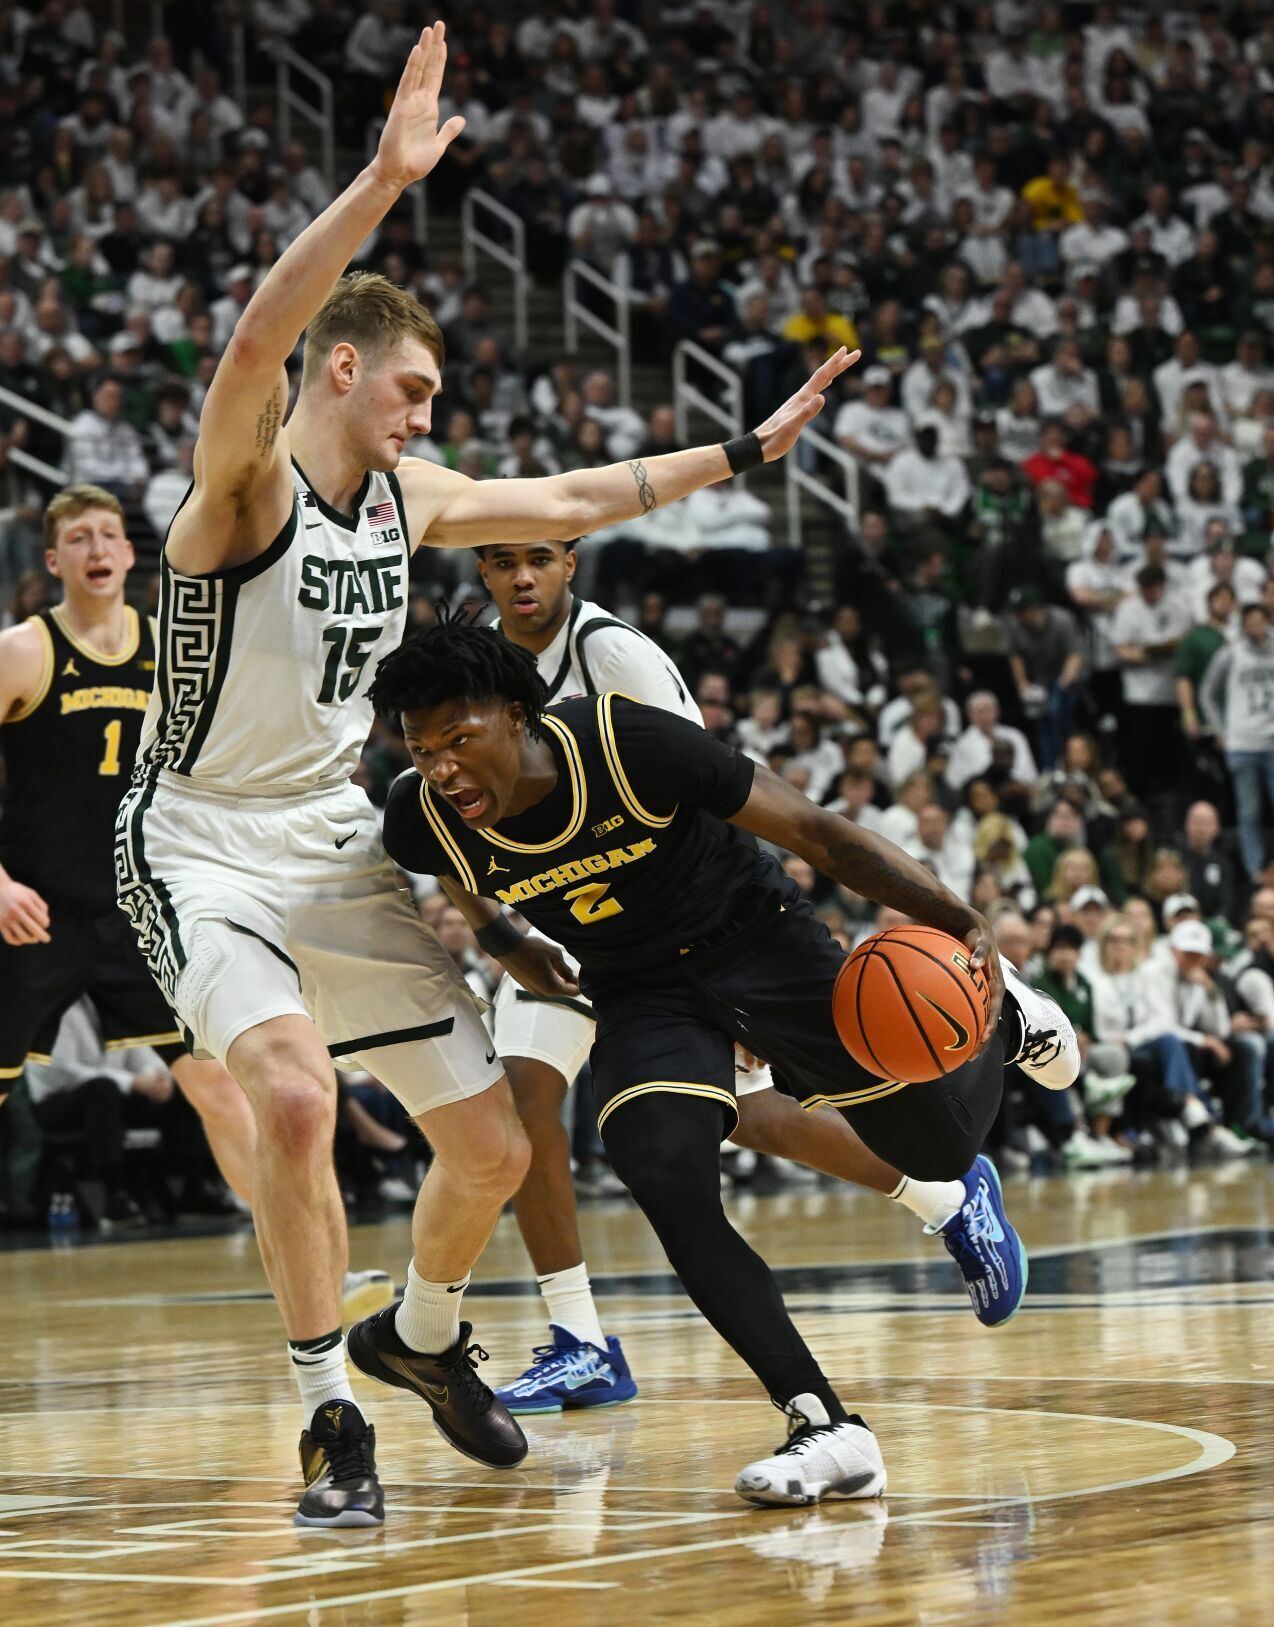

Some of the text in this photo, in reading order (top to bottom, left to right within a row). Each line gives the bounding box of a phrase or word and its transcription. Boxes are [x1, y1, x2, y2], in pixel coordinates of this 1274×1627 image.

[298, 554, 404, 615] STATE
[317, 626, 383, 703] 15
[61, 686, 153, 714] MICHIGA
[98, 719, 121, 775] 1
[494, 838, 657, 905] MICHIGAN
[563, 882, 624, 925] 2
